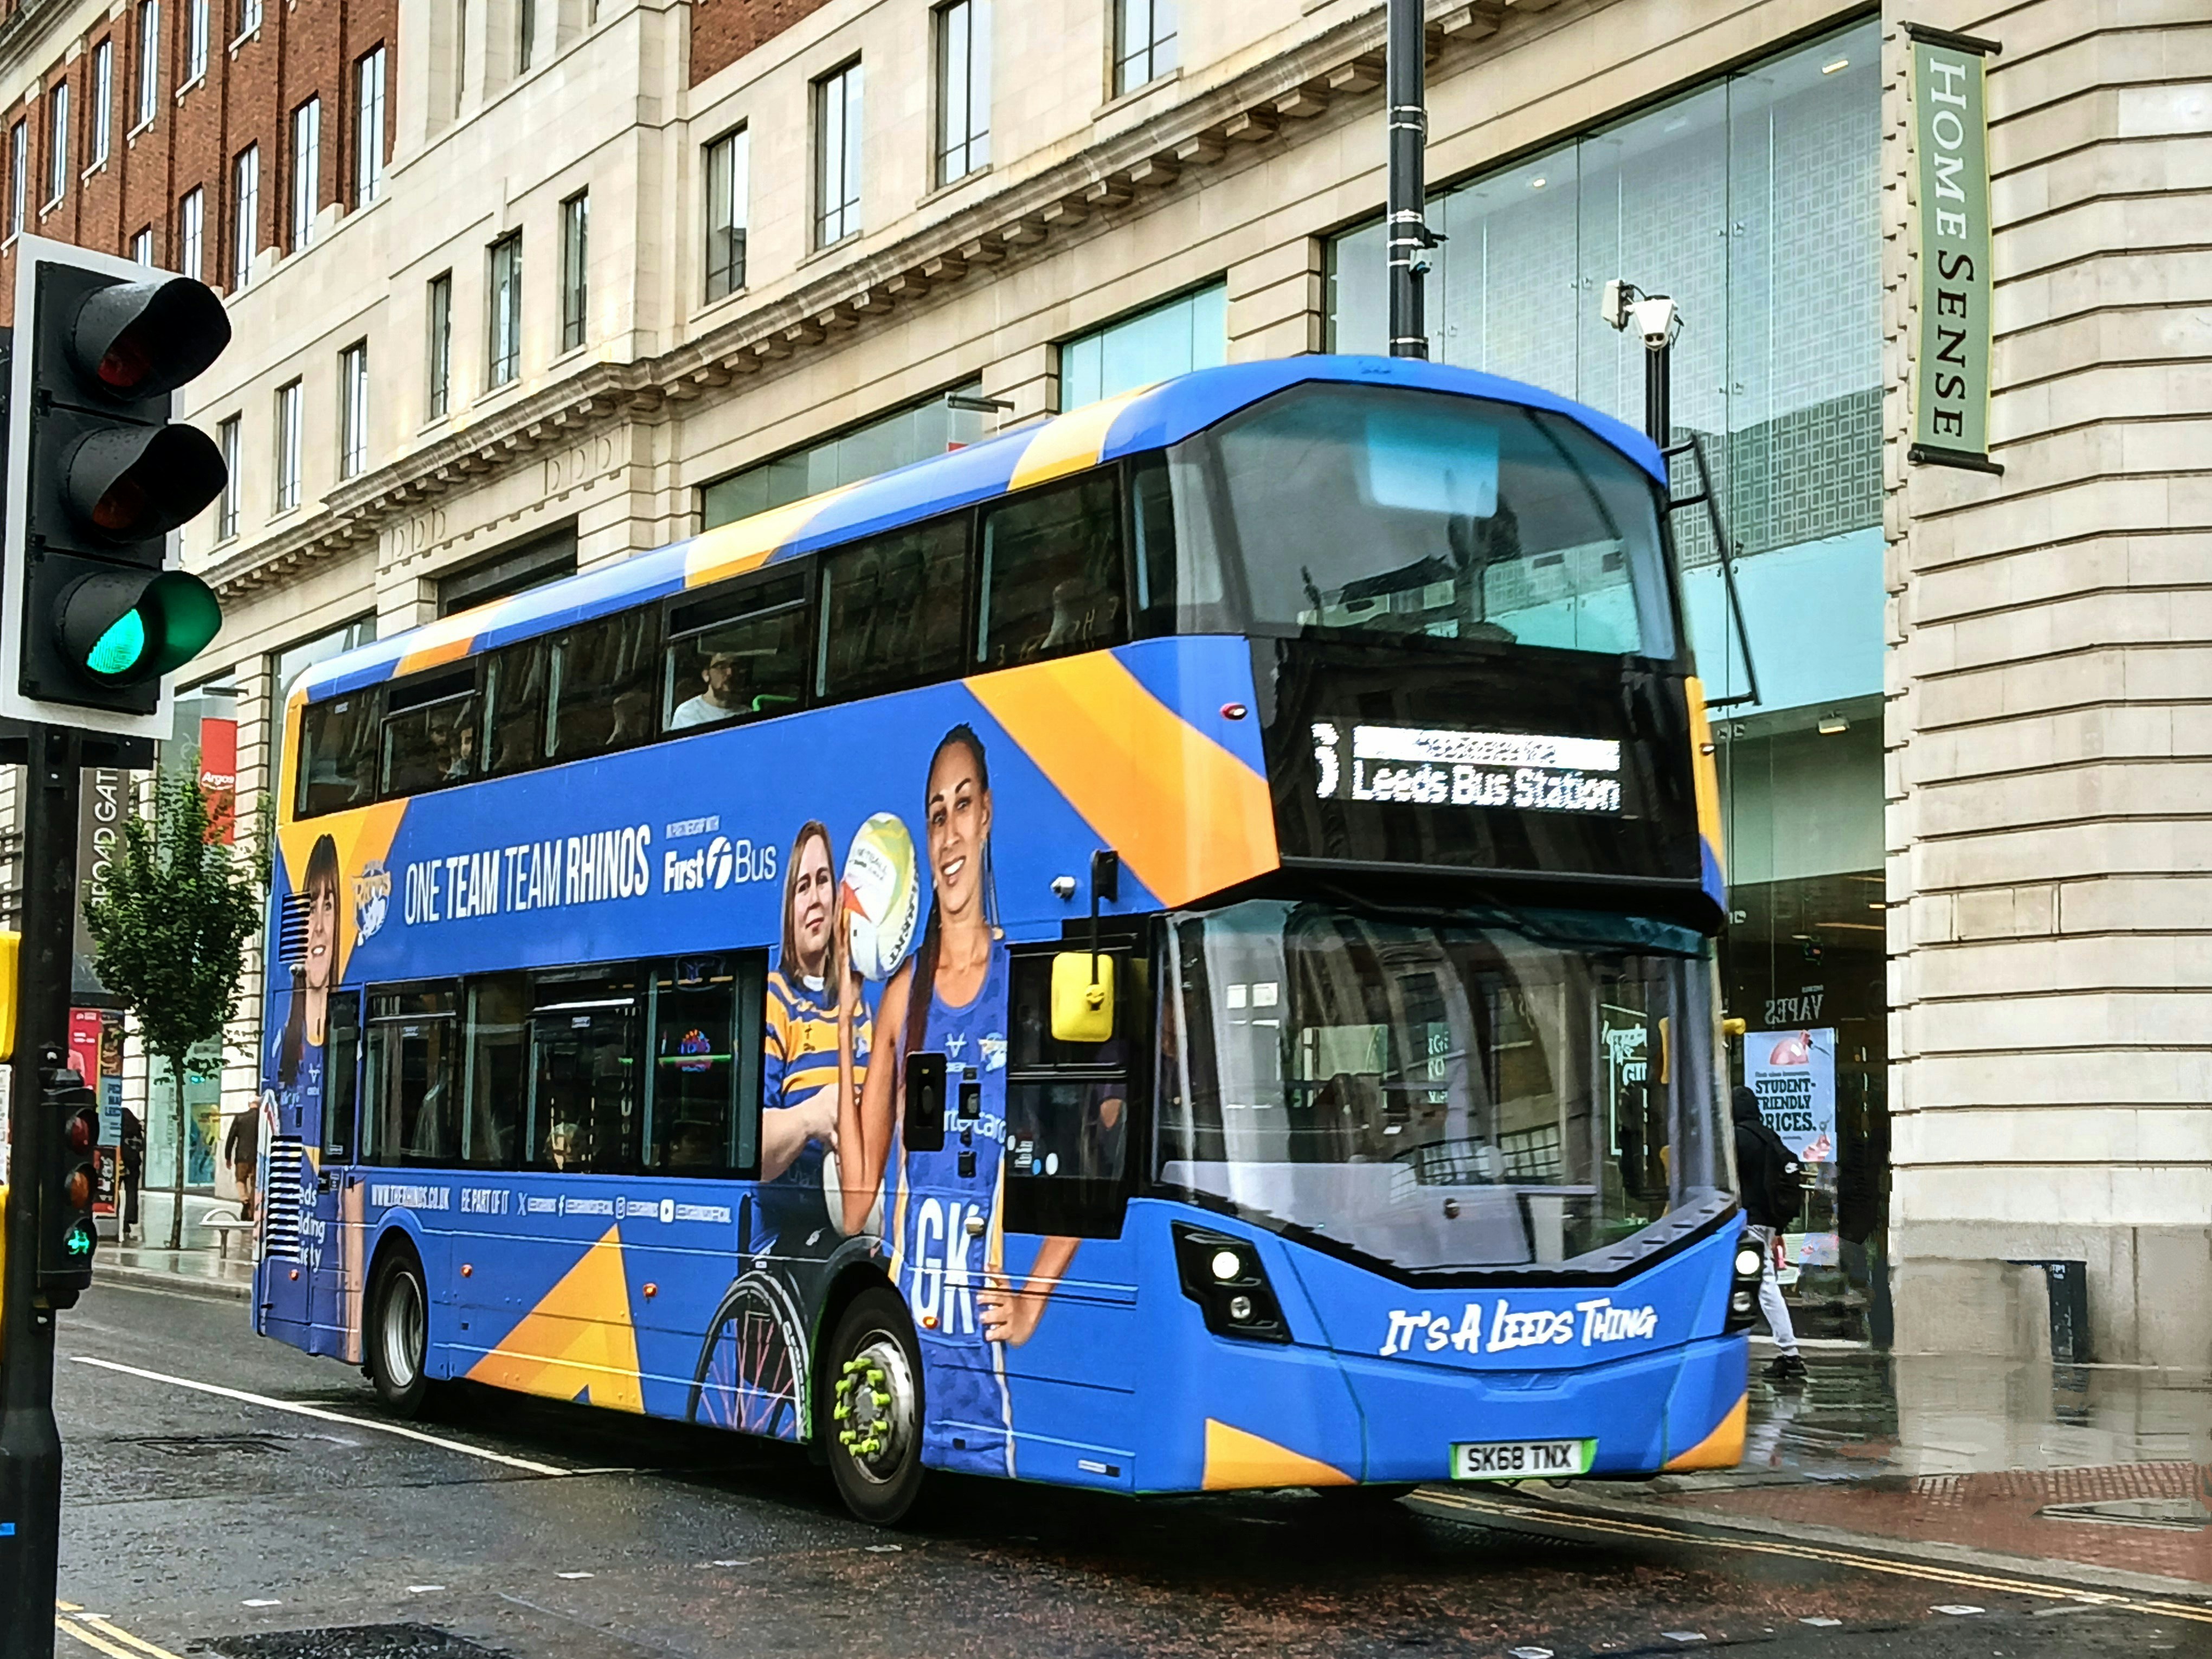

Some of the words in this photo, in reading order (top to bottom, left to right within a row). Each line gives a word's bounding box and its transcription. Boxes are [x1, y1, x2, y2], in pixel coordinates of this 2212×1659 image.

[202, 771, 234, 785] Argos
[1352, 760, 1448, 803] Leeds
[1451, 765, 1512, 806] Bus
[1513, 769, 1622, 811] Station
[404, 858, 442, 925] ONE
[446, 849, 500, 920] TEAM
[504, 839, 562, 912] TEAM
[565, 824, 651, 905] RHINOS
[663, 848, 704, 893] First
[735, 839, 777, 884] Bus
[1451, 1303, 1482, 1354] A
[1468, 1445, 1524, 1472] SK68
[1529, 1443, 1572, 1470] TNX
